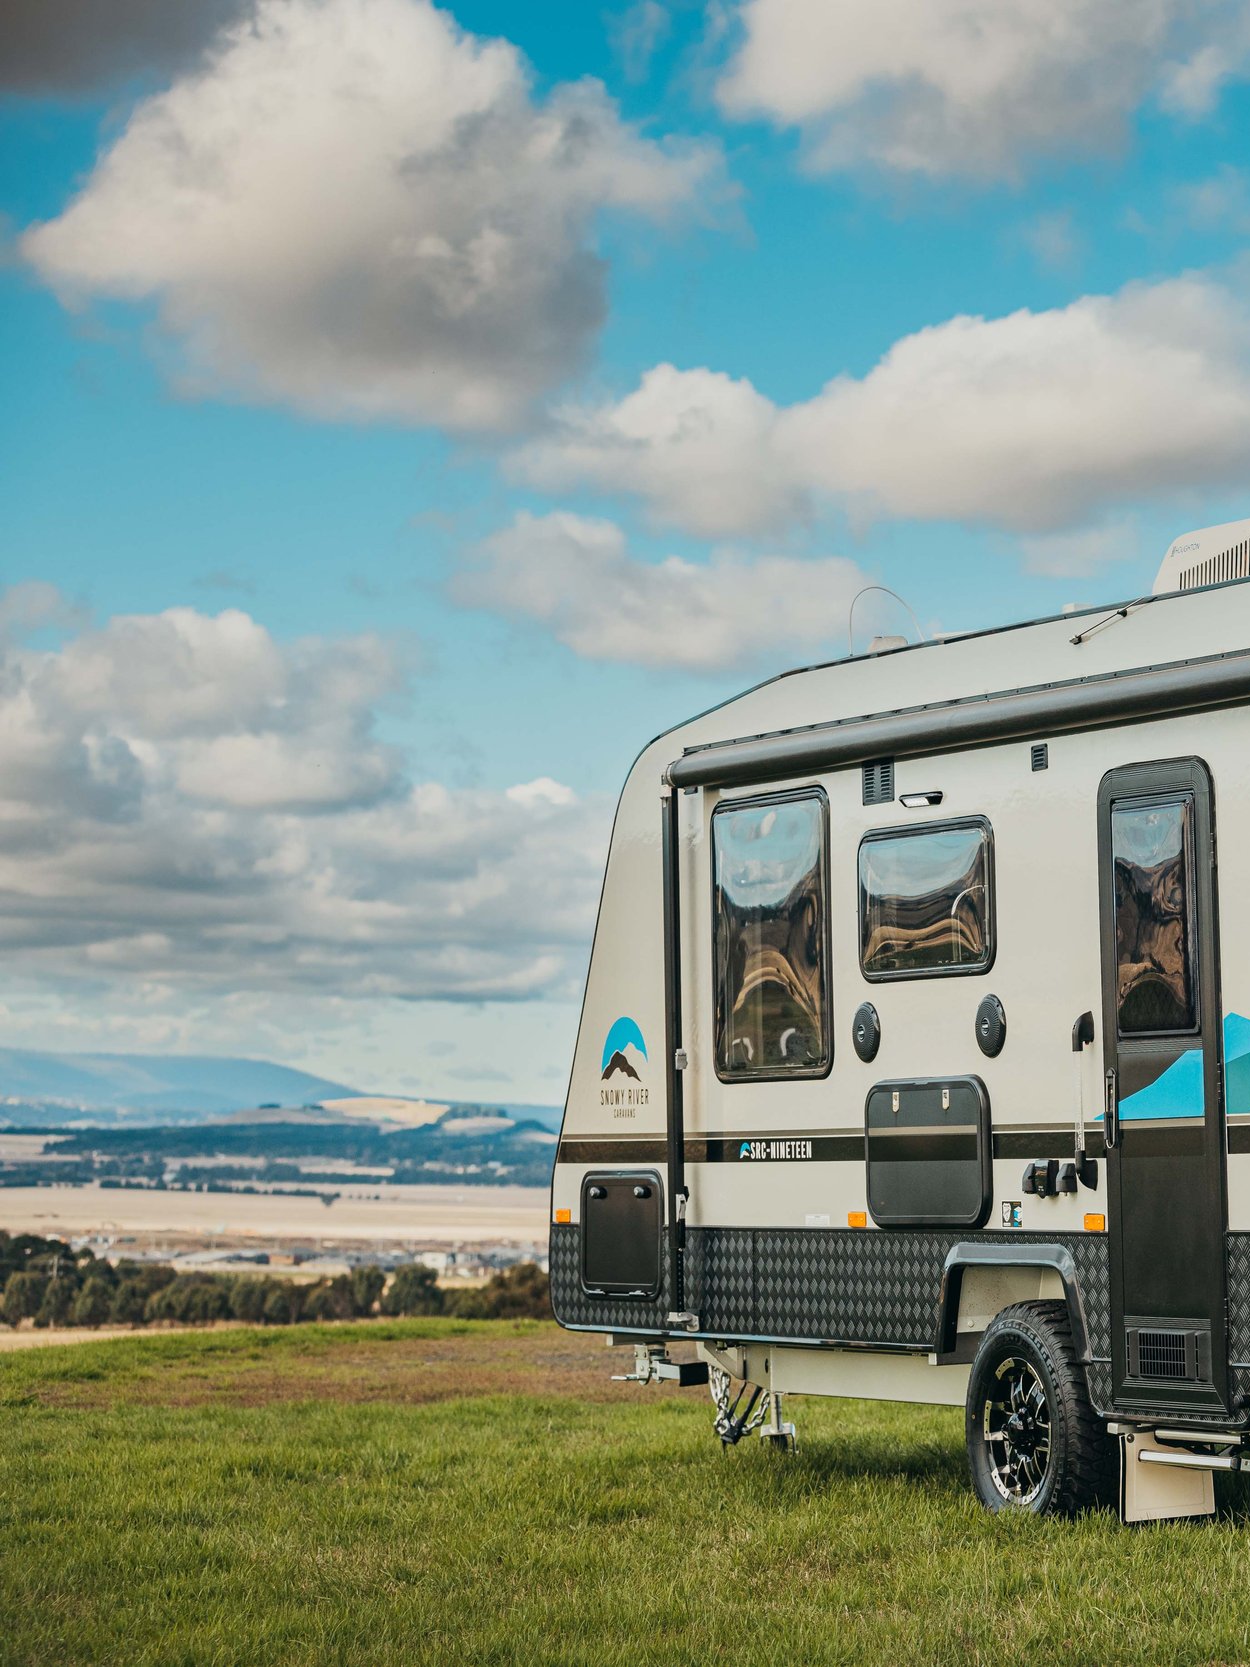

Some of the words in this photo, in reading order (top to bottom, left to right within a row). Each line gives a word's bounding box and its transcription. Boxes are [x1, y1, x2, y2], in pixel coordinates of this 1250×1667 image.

[600, 1089, 625, 1105] SNOWY
[627, 1088, 649, 1105] RIVER
[613, 1108, 636, 1118] CARAVANS
[750, 1141, 812, 1159] SRC-NINETEEN
